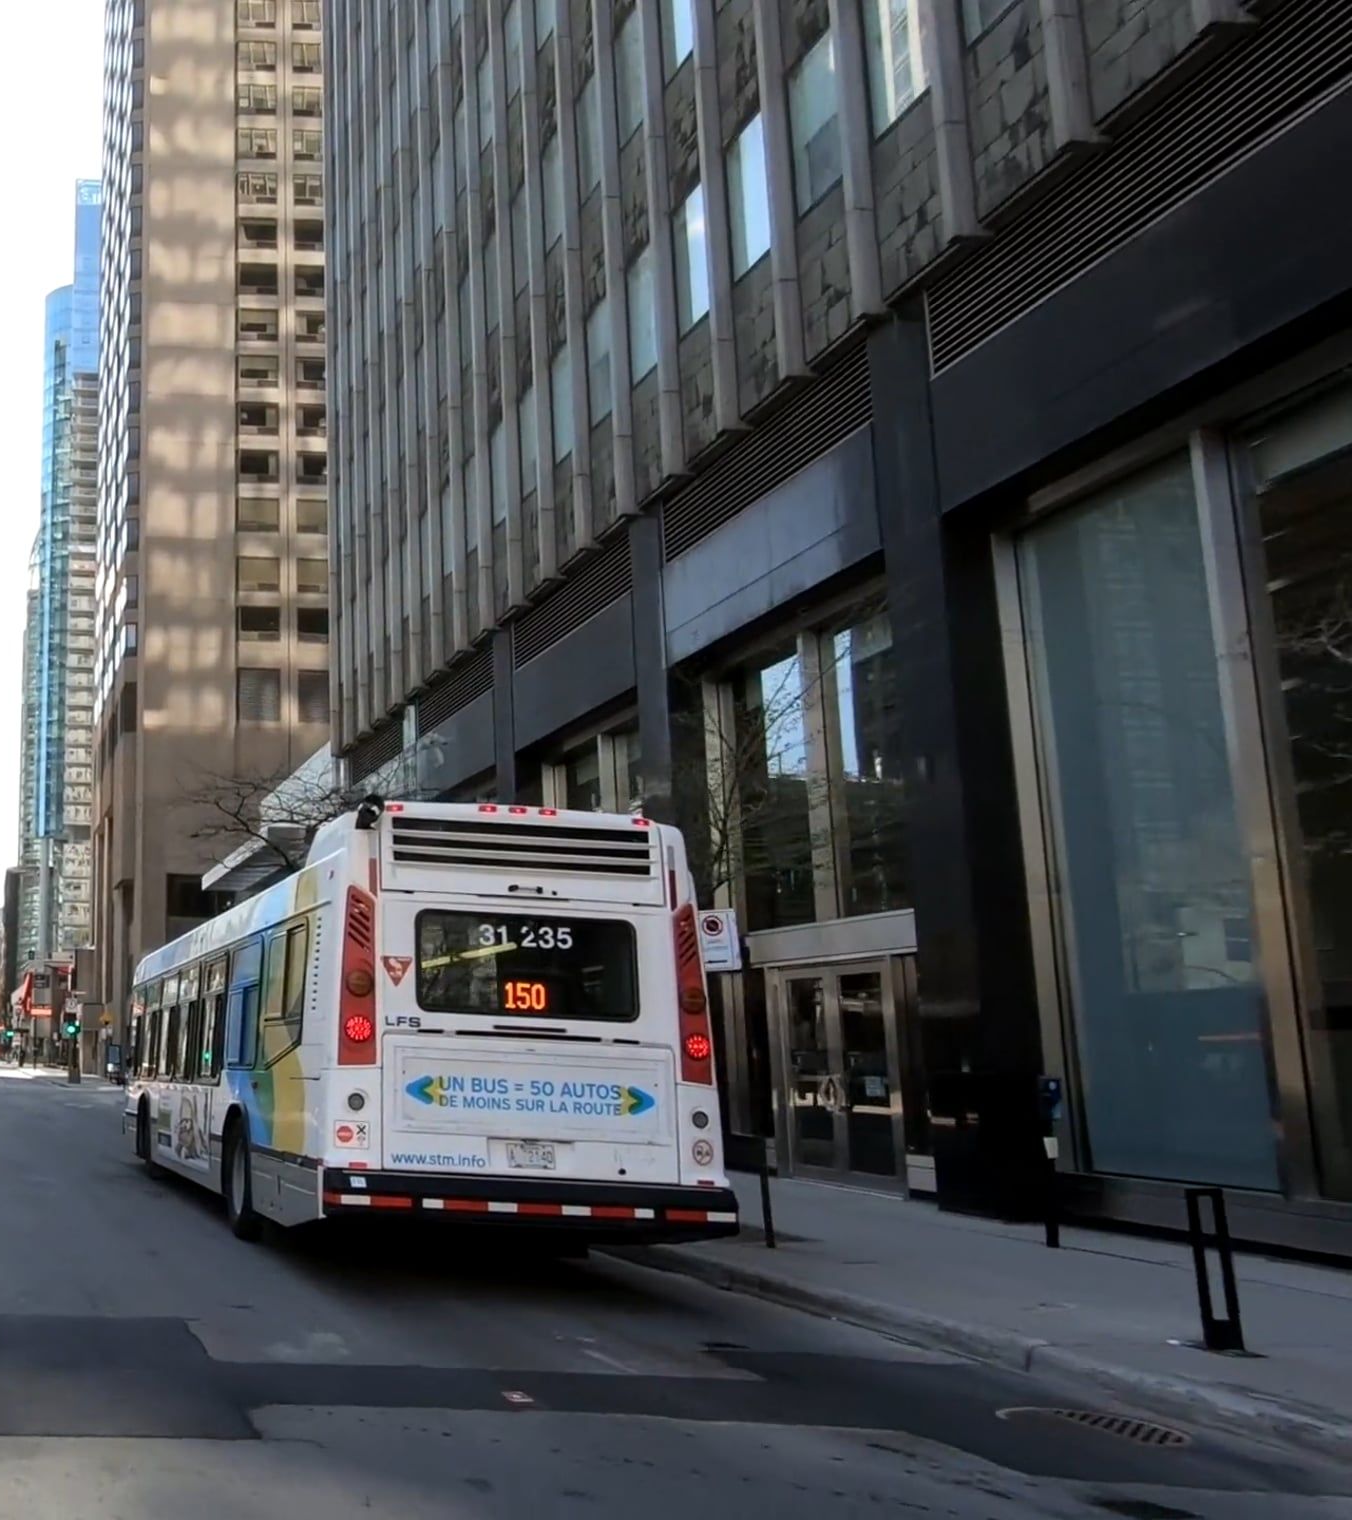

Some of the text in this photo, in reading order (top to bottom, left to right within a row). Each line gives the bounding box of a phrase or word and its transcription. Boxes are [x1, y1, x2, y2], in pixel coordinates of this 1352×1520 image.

[478, 924, 573, 949] 31 235
[505, 982, 546, 1010] 150
[385, 1015, 422, 1028] LFS
[438, 1075, 465, 1093] UN
[471, 1077, 509, 1095] BUS
[530, 1080, 554, 1098] 50
[560, 1082, 622, 1101] AUTOS
[438, 1095, 622, 1116] DE MOINS SUR LA ROUTE
[391, 1151, 486, 1168] www.stm.info
